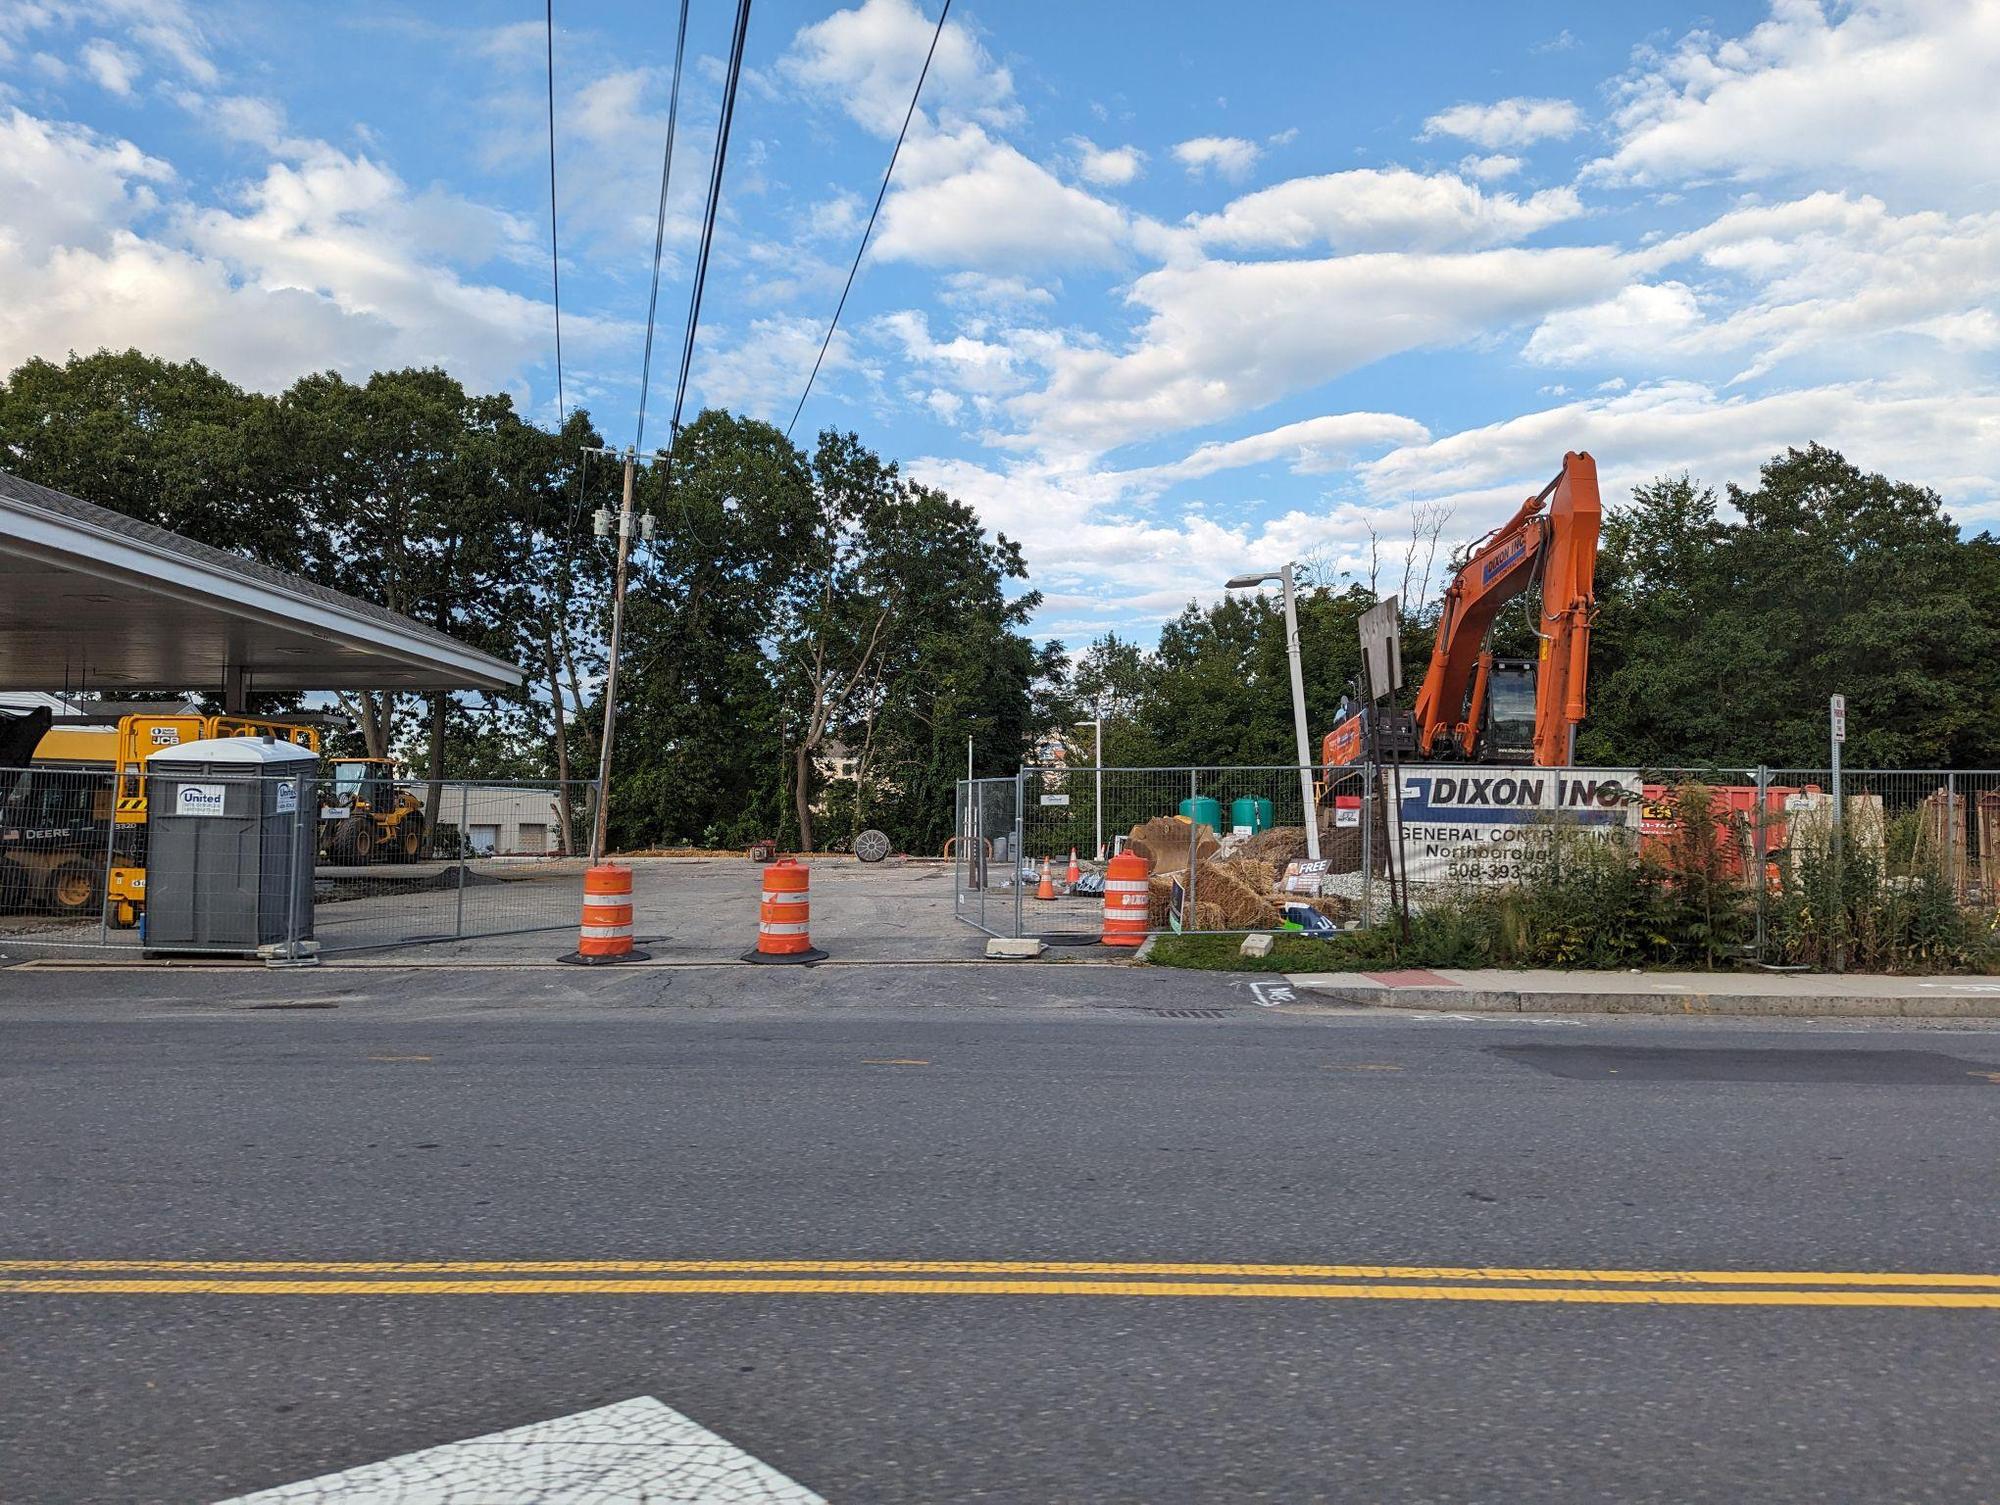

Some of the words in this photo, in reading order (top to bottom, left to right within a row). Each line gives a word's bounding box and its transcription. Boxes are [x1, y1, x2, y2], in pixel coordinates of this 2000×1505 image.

[152, 736, 180, 746] JCB
[1431, 778, 1544, 806] DIXON
[184, 794, 221, 803] United
[26, 828, 71, 839] DEERE
[1402, 827, 1484, 841] GENERAL
[1299, 860, 1328, 874] FREE
